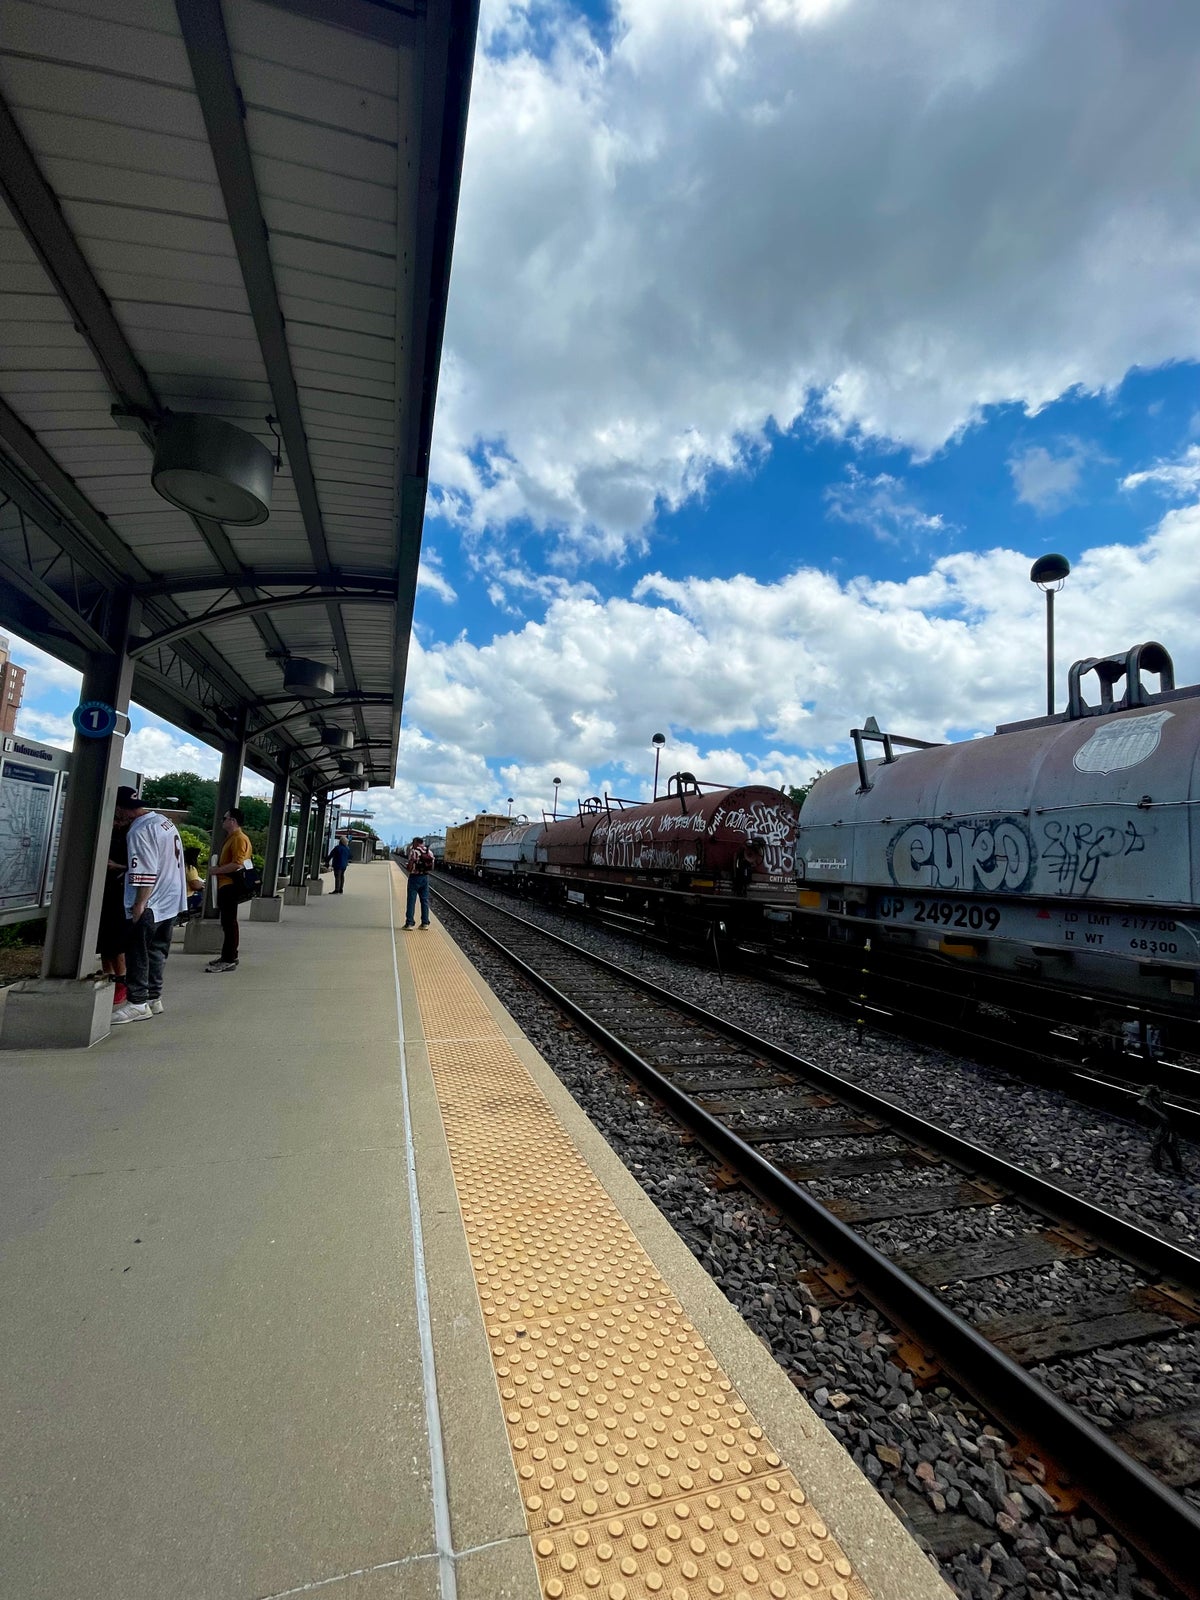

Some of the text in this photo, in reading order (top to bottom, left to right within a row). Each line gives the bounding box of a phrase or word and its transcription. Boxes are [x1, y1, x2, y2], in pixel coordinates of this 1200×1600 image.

[89, 710, 100, 729] 1
[14, 742, 53, 761] Information
[131, 857, 138, 868] 6
[880, 897, 1001, 931] UP 249209
[1064, 912, 1177, 932] LD LMT 217700
[1065, 930, 1178, 953] LT WT 68300
